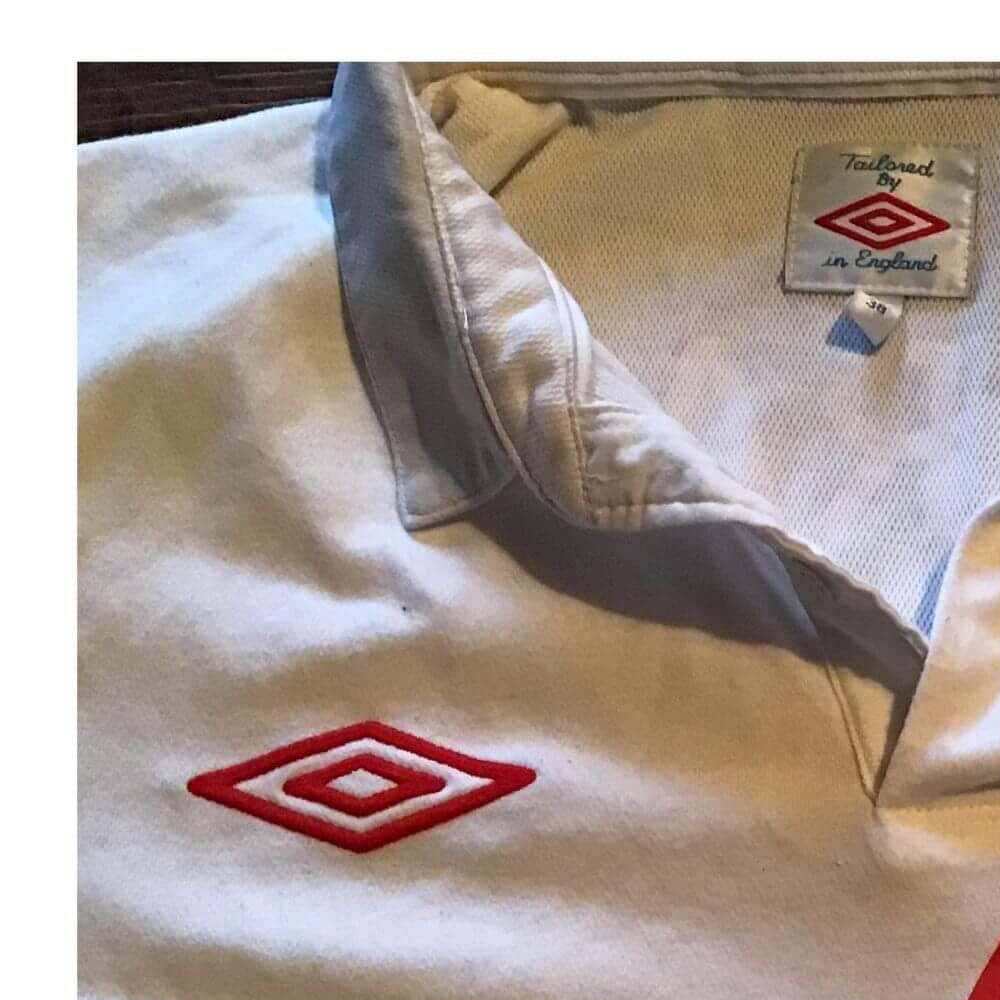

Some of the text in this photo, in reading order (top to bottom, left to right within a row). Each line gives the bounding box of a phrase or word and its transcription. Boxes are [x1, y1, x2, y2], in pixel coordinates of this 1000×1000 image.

[841, 153, 934, 177] Tailored
[876, 173, 902, 192] By
[821, 249, 938, 273] in England
